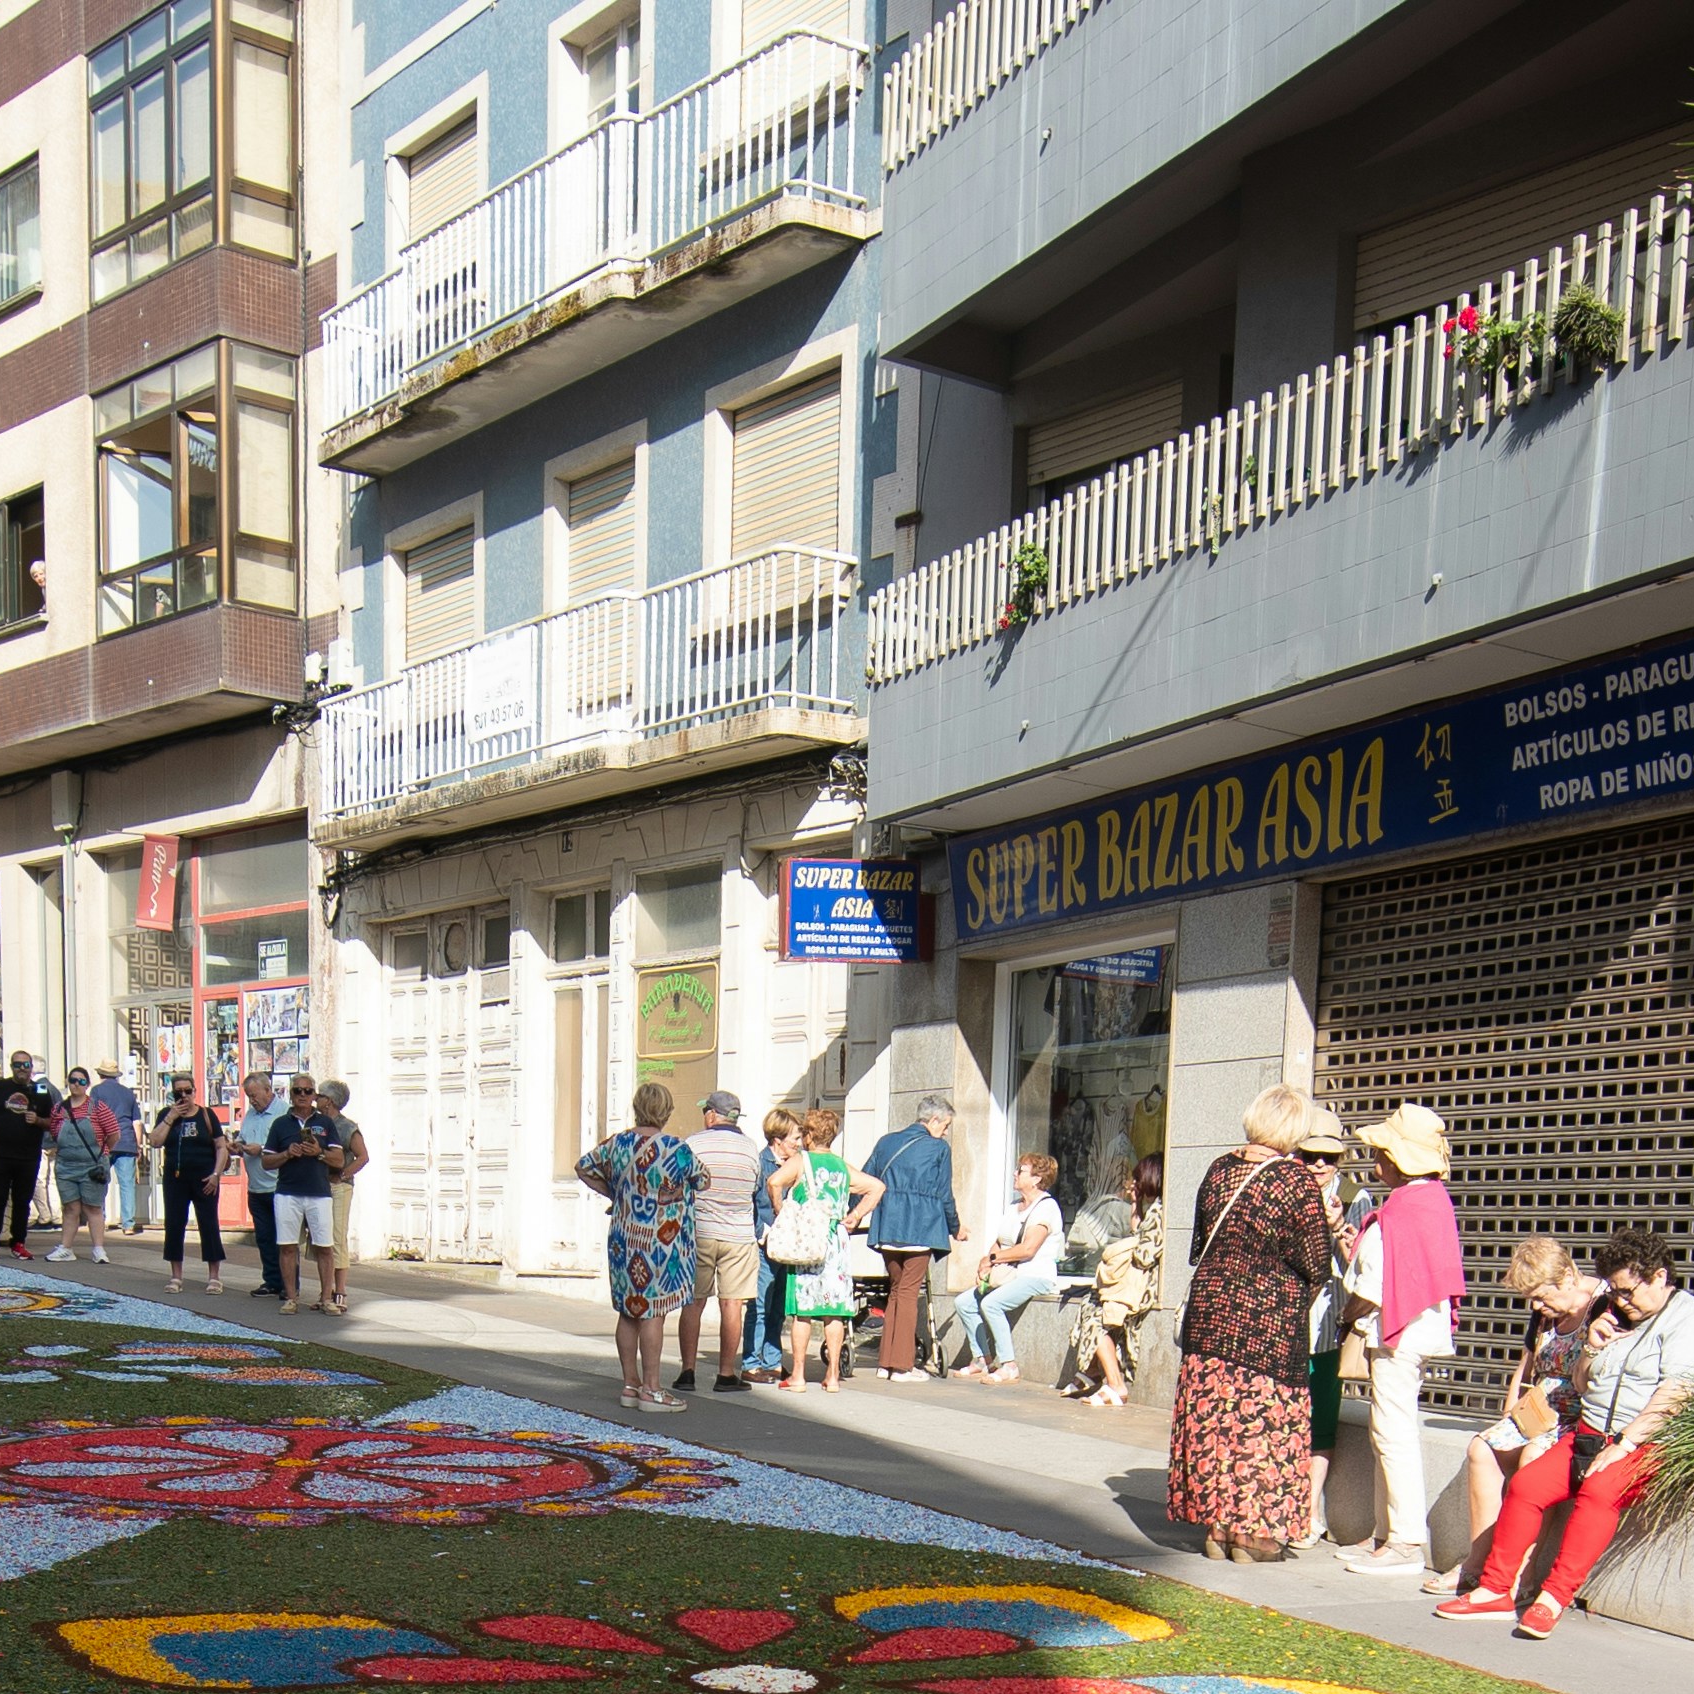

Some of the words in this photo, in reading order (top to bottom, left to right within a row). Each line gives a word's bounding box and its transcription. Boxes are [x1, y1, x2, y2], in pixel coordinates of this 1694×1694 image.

[1505, 682, 1587, 728] BOLSOS
[1511, 719, 1630, 771] ARTÍCULOS
[1637, 711, 1667, 742] DE
[1539, 775, 1595, 811] ROPA
[1600, 767, 1630, 796] DE
[966, 819, 1087, 930] SUPER
[1097, 776, 1245, 902] BAZAR
[1256, 736, 1384, 869] ASIA
[794, 866, 854, 890] SUPER
[855, 869, 915, 892] BAZAR
[831, 896, 875, 919] ASIA
[795, 922, 826, 932] BOLSOS
[830, 923, 870, 933] PARAGUAS
[874, 924, 914, 934] JUGUETES
[840, 935, 850, 944] DE
[851, 935, 880, 945] REGALO
[885, 936, 912, 945] HOGAR
[805, 945, 826, 954] ROPA
[827, 946, 837, 955] DE
